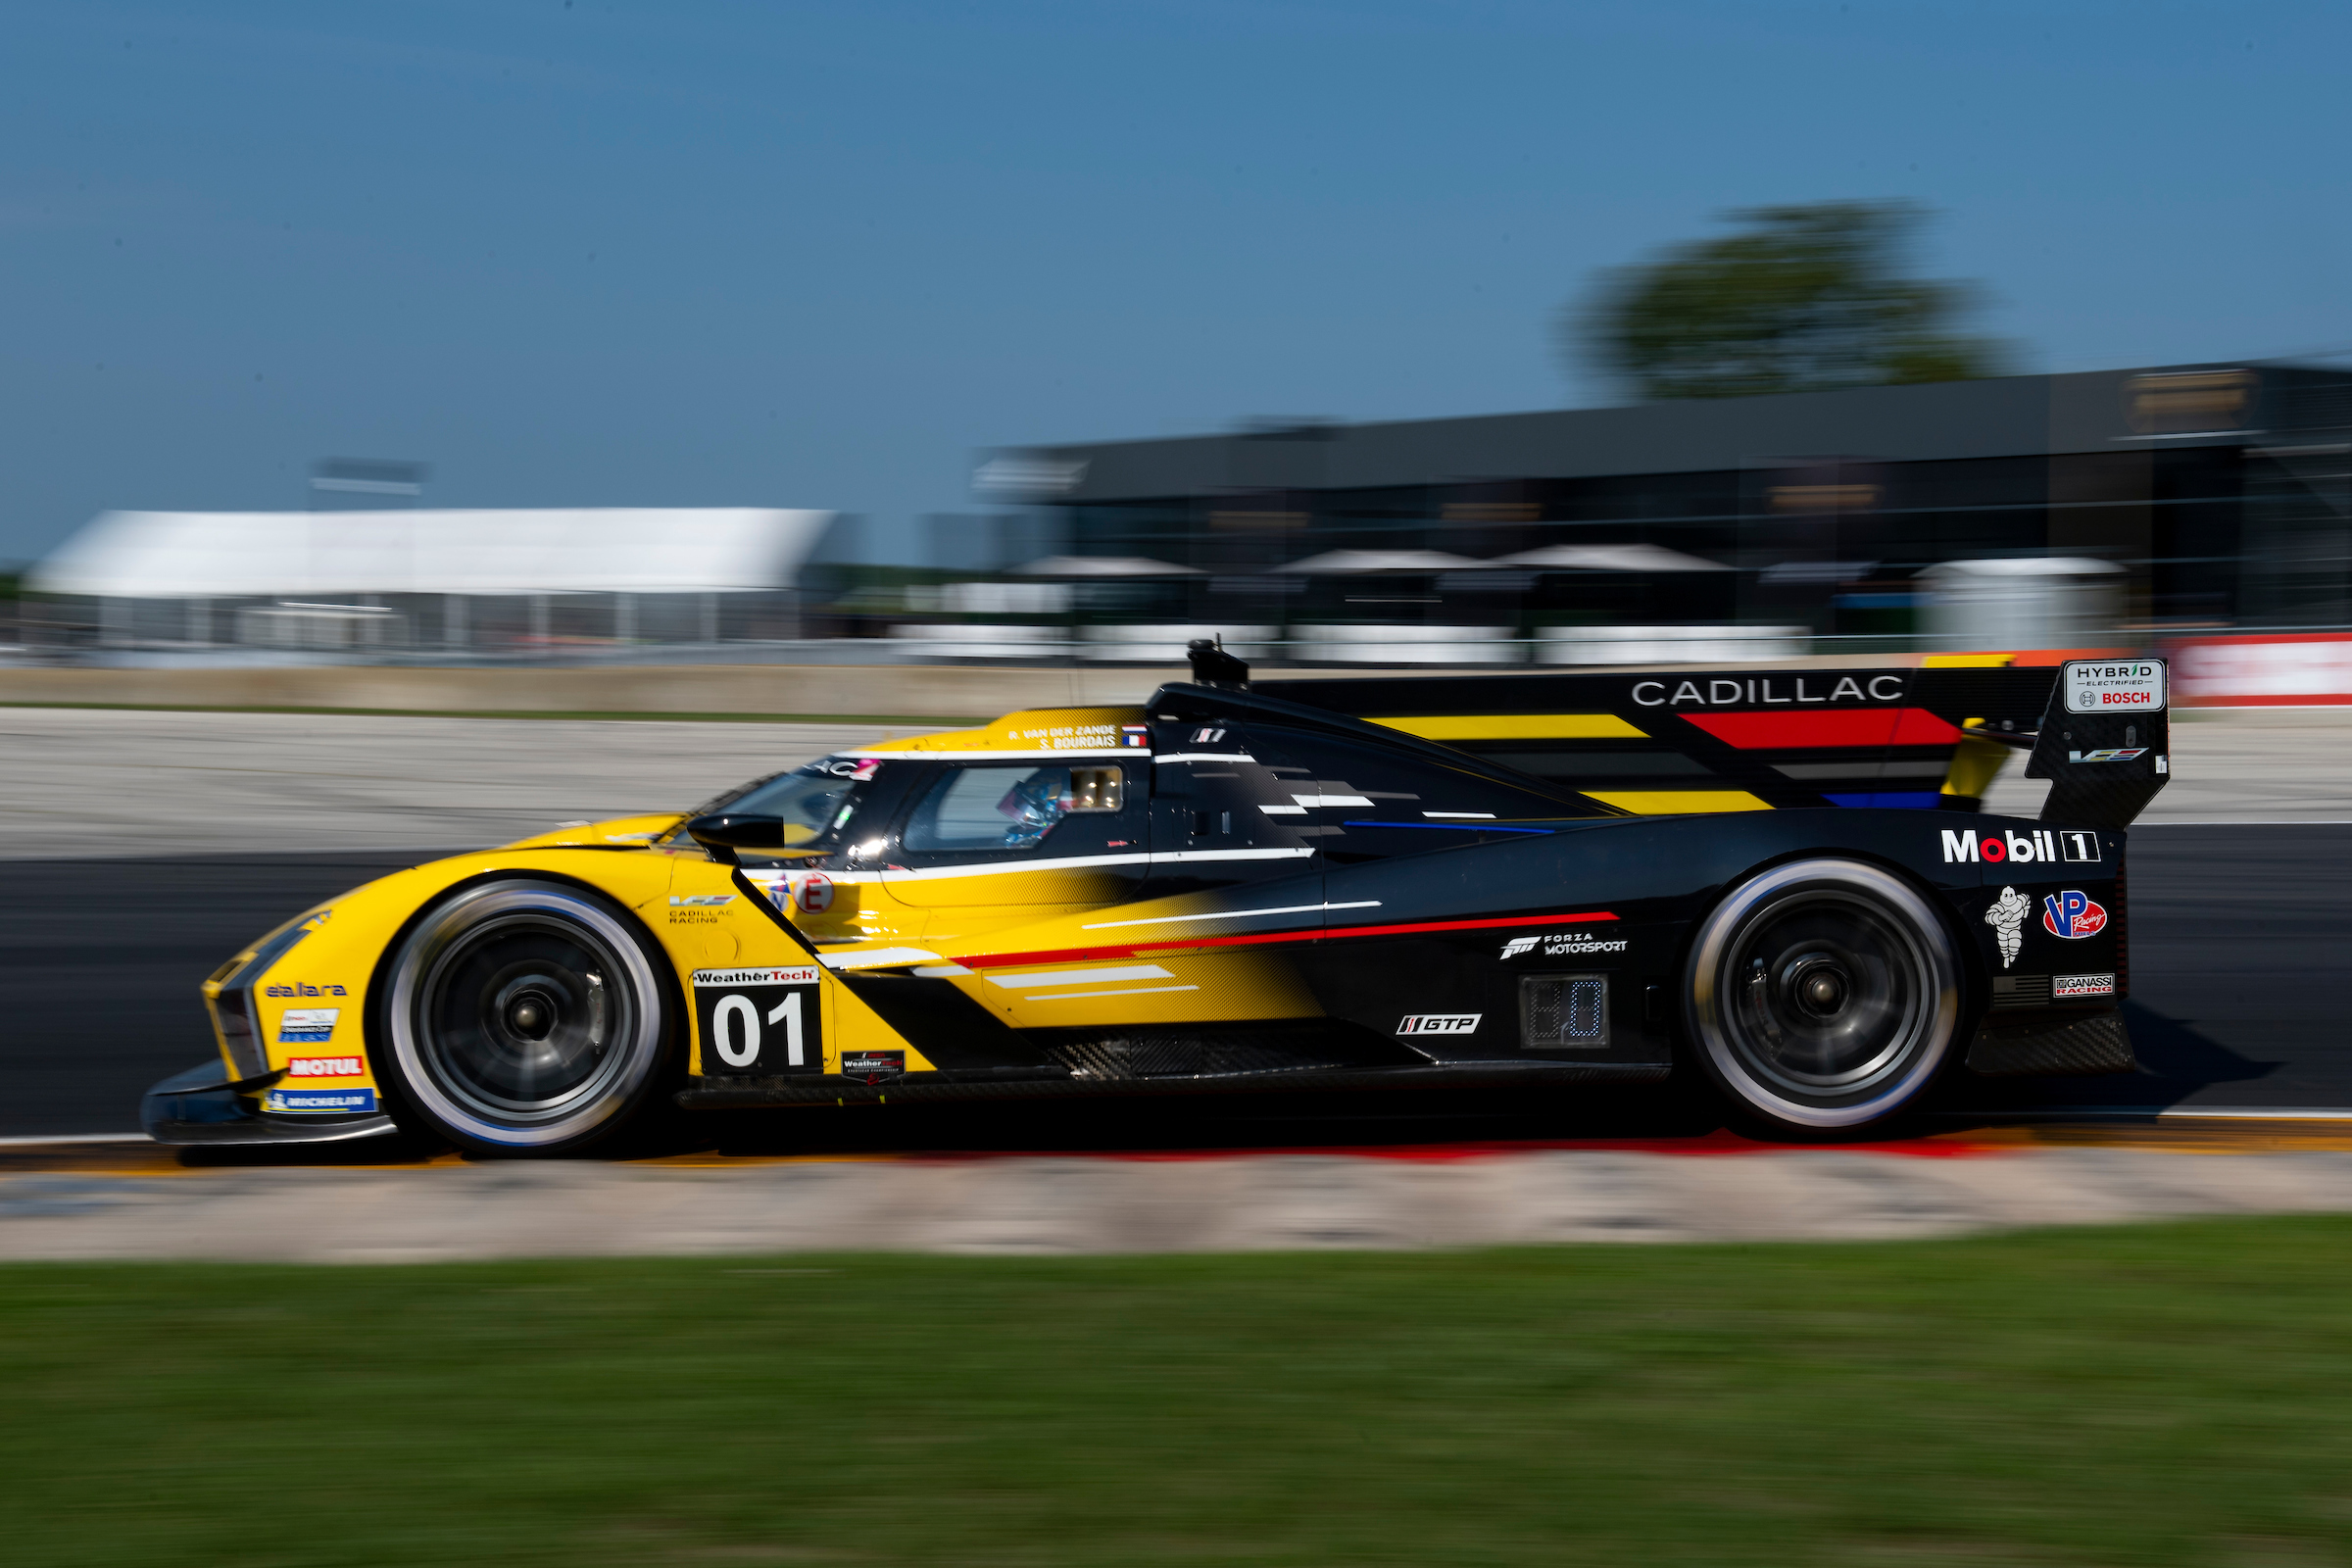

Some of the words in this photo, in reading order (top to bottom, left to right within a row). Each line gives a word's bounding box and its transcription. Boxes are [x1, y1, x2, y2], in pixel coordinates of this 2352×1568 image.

[2078, 664, 2152, 678] HYBRID
[1631, 675, 1904, 707] CADILLAC
[2102, 692, 2151, 704] BOSCH
[1023, 728, 1049, 739] VAN
[1050, 726, 1074, 737] DER
[1075, 724, 1116, 735] ZANDE
[1054, 735, 1116, 748] BOURDAIS
[1940, 829, 2057, 863] Mobil
[2071, 833, 2088, 860] 1
[805, 878, 823, 910] E
[2043, 890, 2088, 938] VP
[2074, 912, 2106, 932] Racing
[1544, 933, 1593, 944] FORZA
[1544, 940, 1629, 956] MOTORSPORT
[697, 969, 813, 983] WeatherTech
[2067, 977, 2112, 988] GANASSI
[712, 992, 805, 1068] 01
[1424, 1018, 1475, 1031] GTP
[289, 1057, 363, 1076] MOTUL
[844, 1059, 903, 1068] WeatherTech
[286, 1096, 366, 1107] MICHELIN
